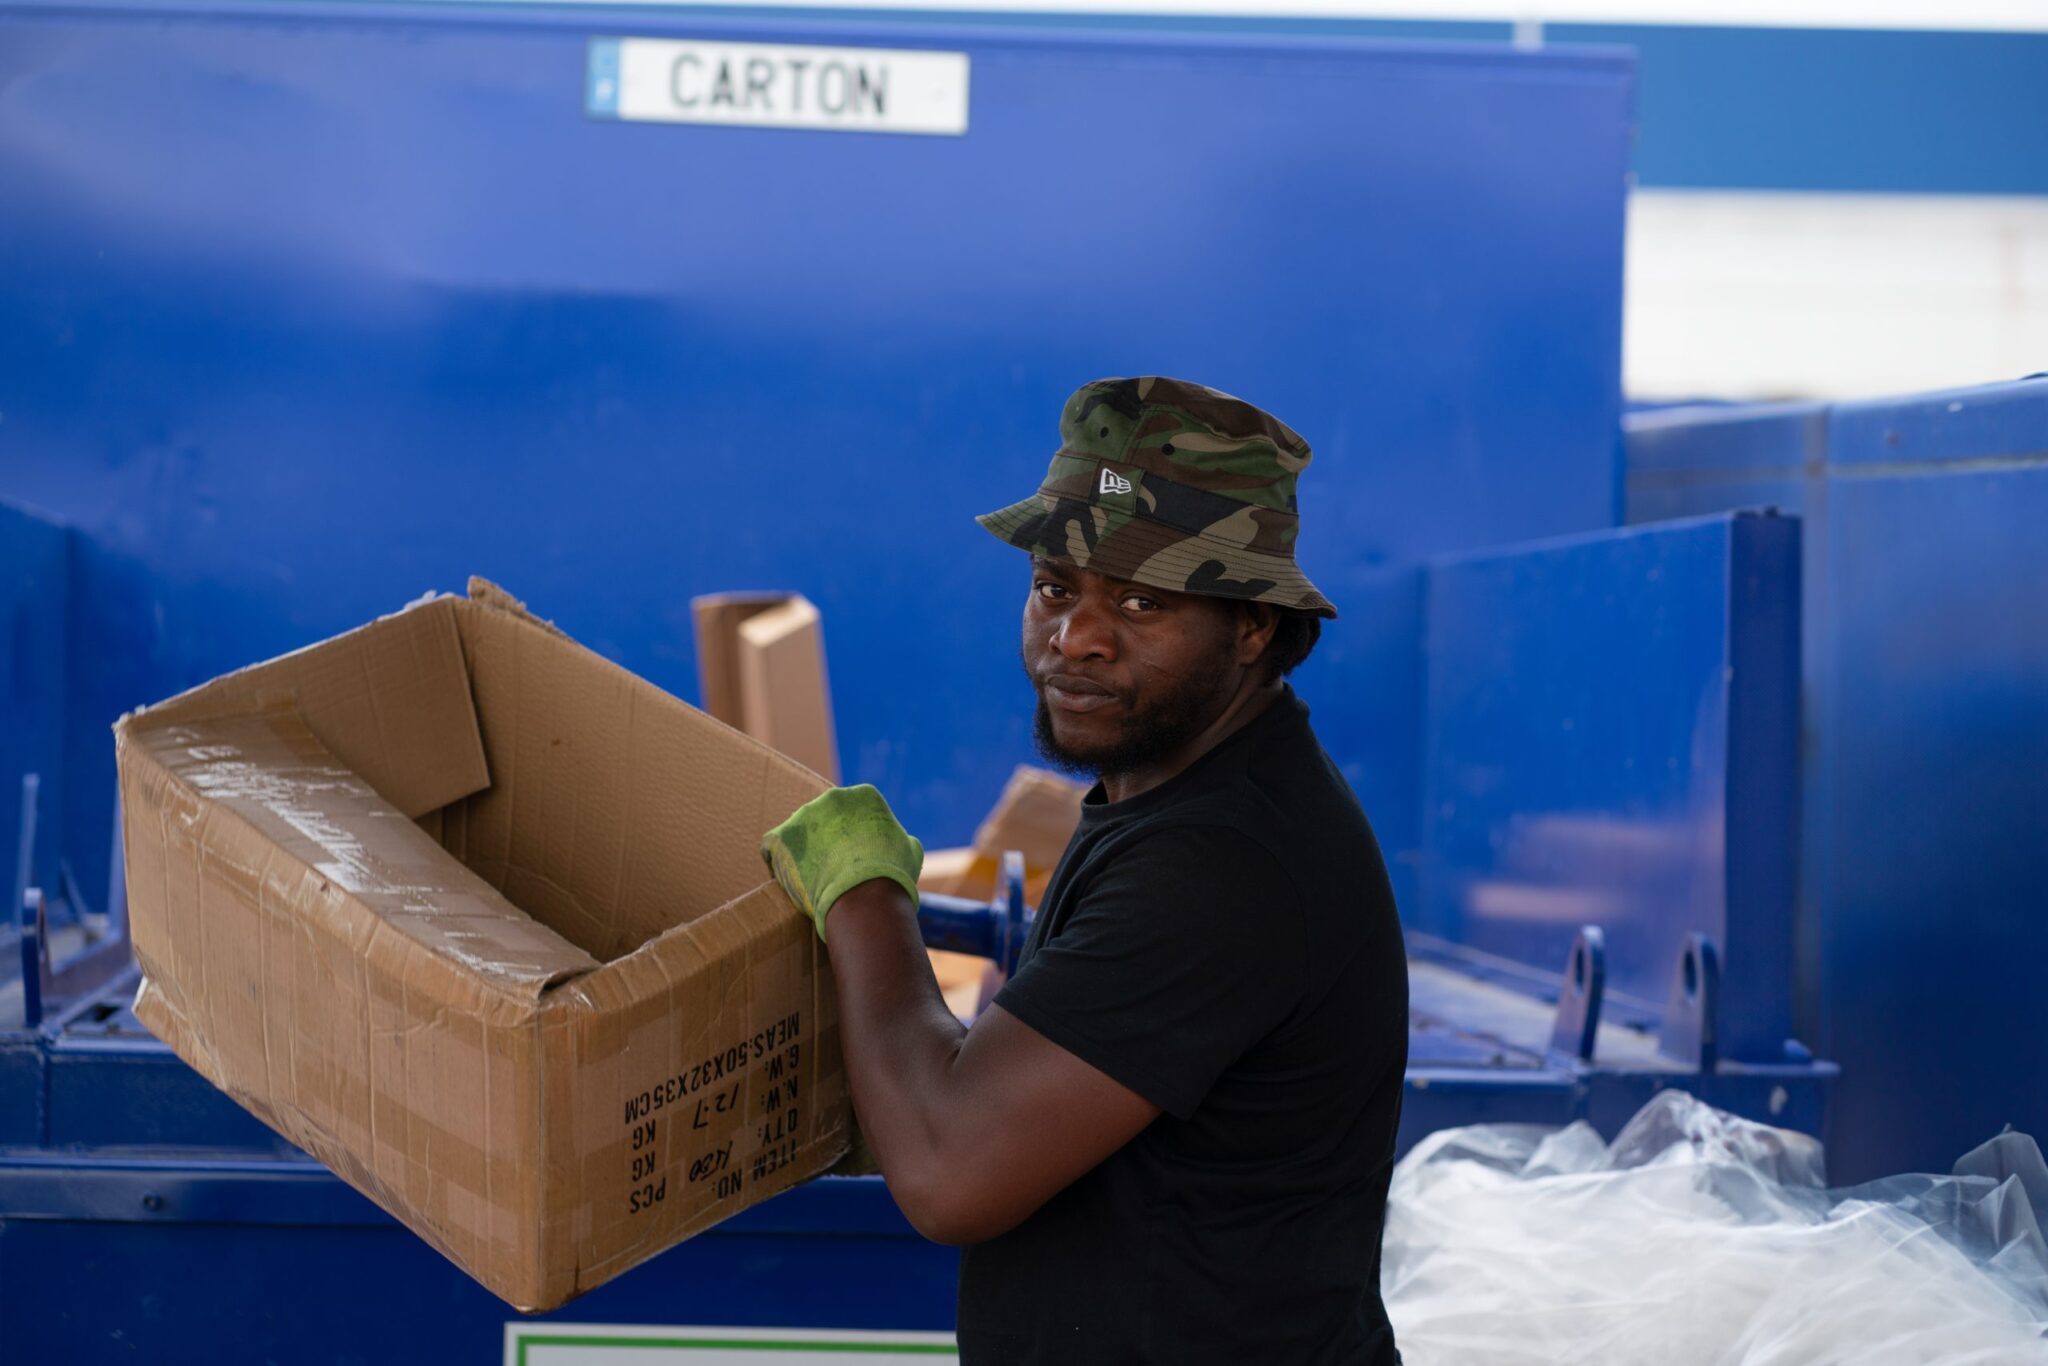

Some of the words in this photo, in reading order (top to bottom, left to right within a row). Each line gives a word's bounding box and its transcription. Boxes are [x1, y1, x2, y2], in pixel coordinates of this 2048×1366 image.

[671, 52, 888, 116] CARTON
[692, 1082, 740, 1130] 12.7
[632, 1119, 656, 1150] KG
[758, 1107, 798, 1146] QTY:
[632, 1151, 656, 1182] KG
[753, 1140, 796, 1181] ITEM
[630, 1177, 666, 1214] PCS
